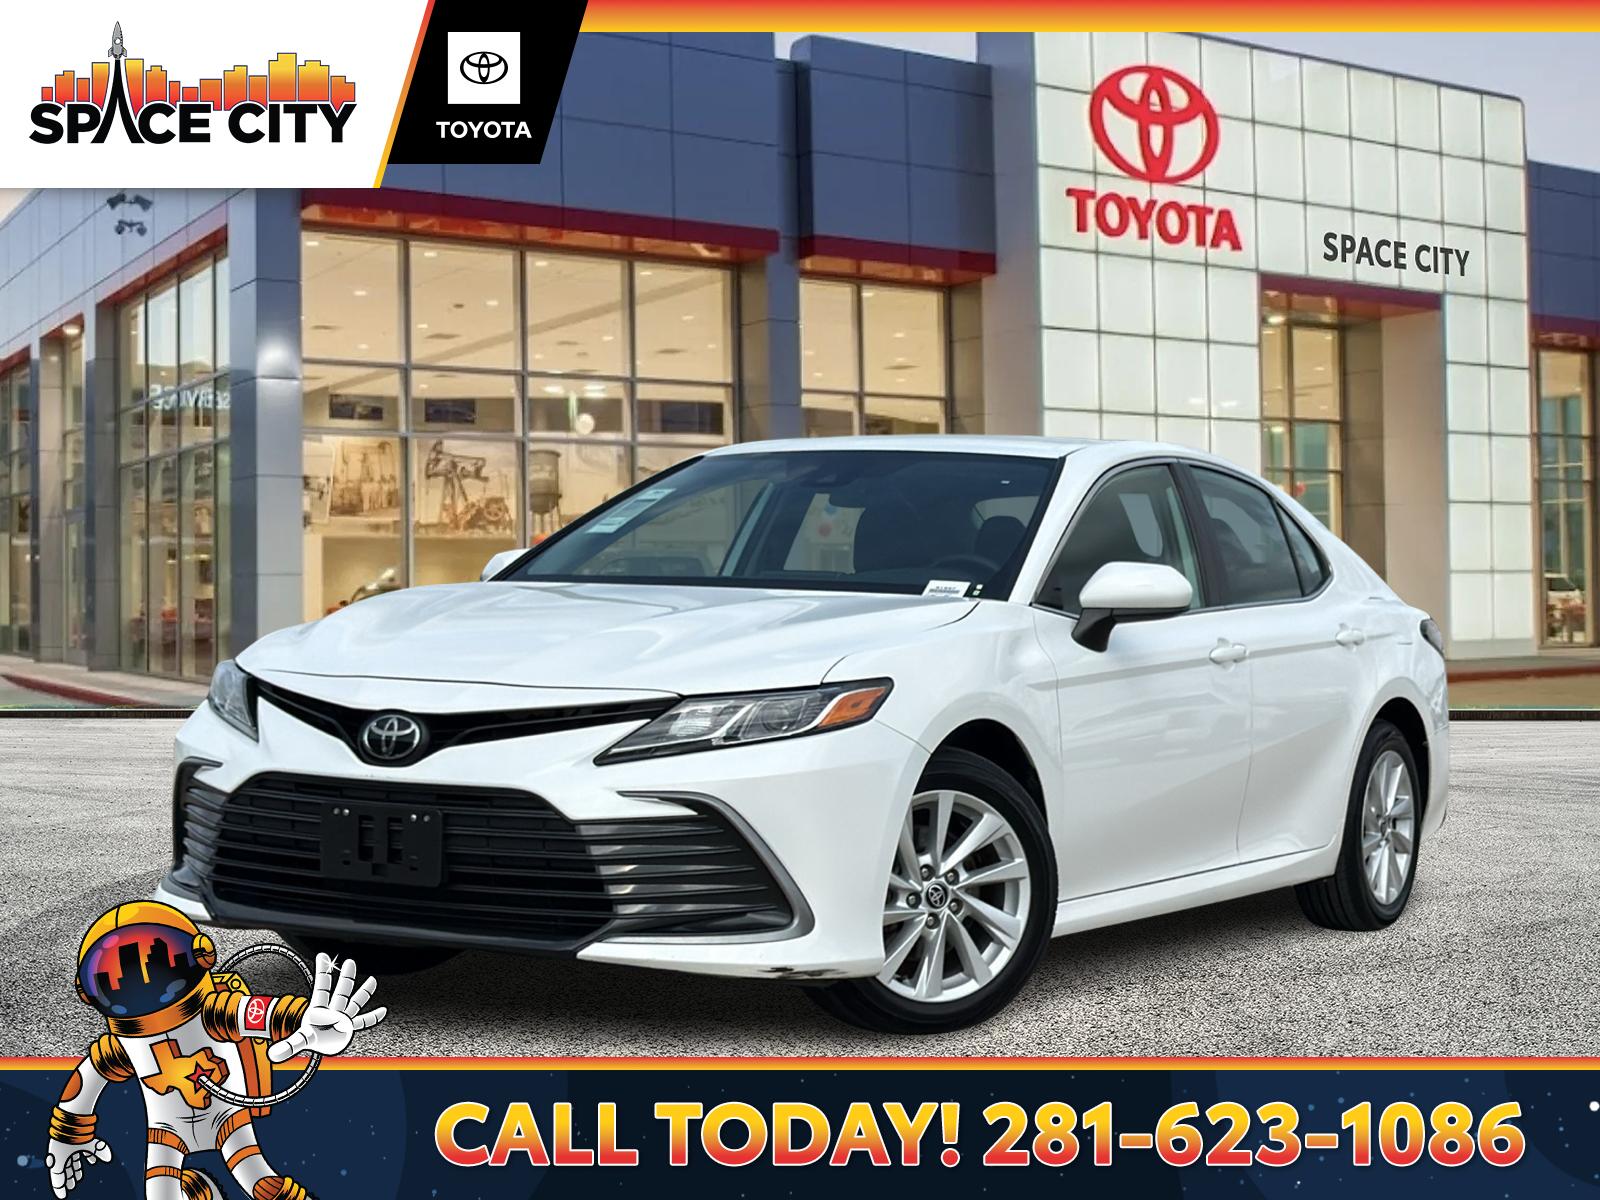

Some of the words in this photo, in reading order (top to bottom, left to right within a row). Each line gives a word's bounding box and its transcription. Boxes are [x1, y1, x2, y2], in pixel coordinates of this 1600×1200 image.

[1066, 188, 1242, 251] TOYOTA
[1322, 231, 1407, 270] SPACE
[1414, 243, 1470, 276] CITY
